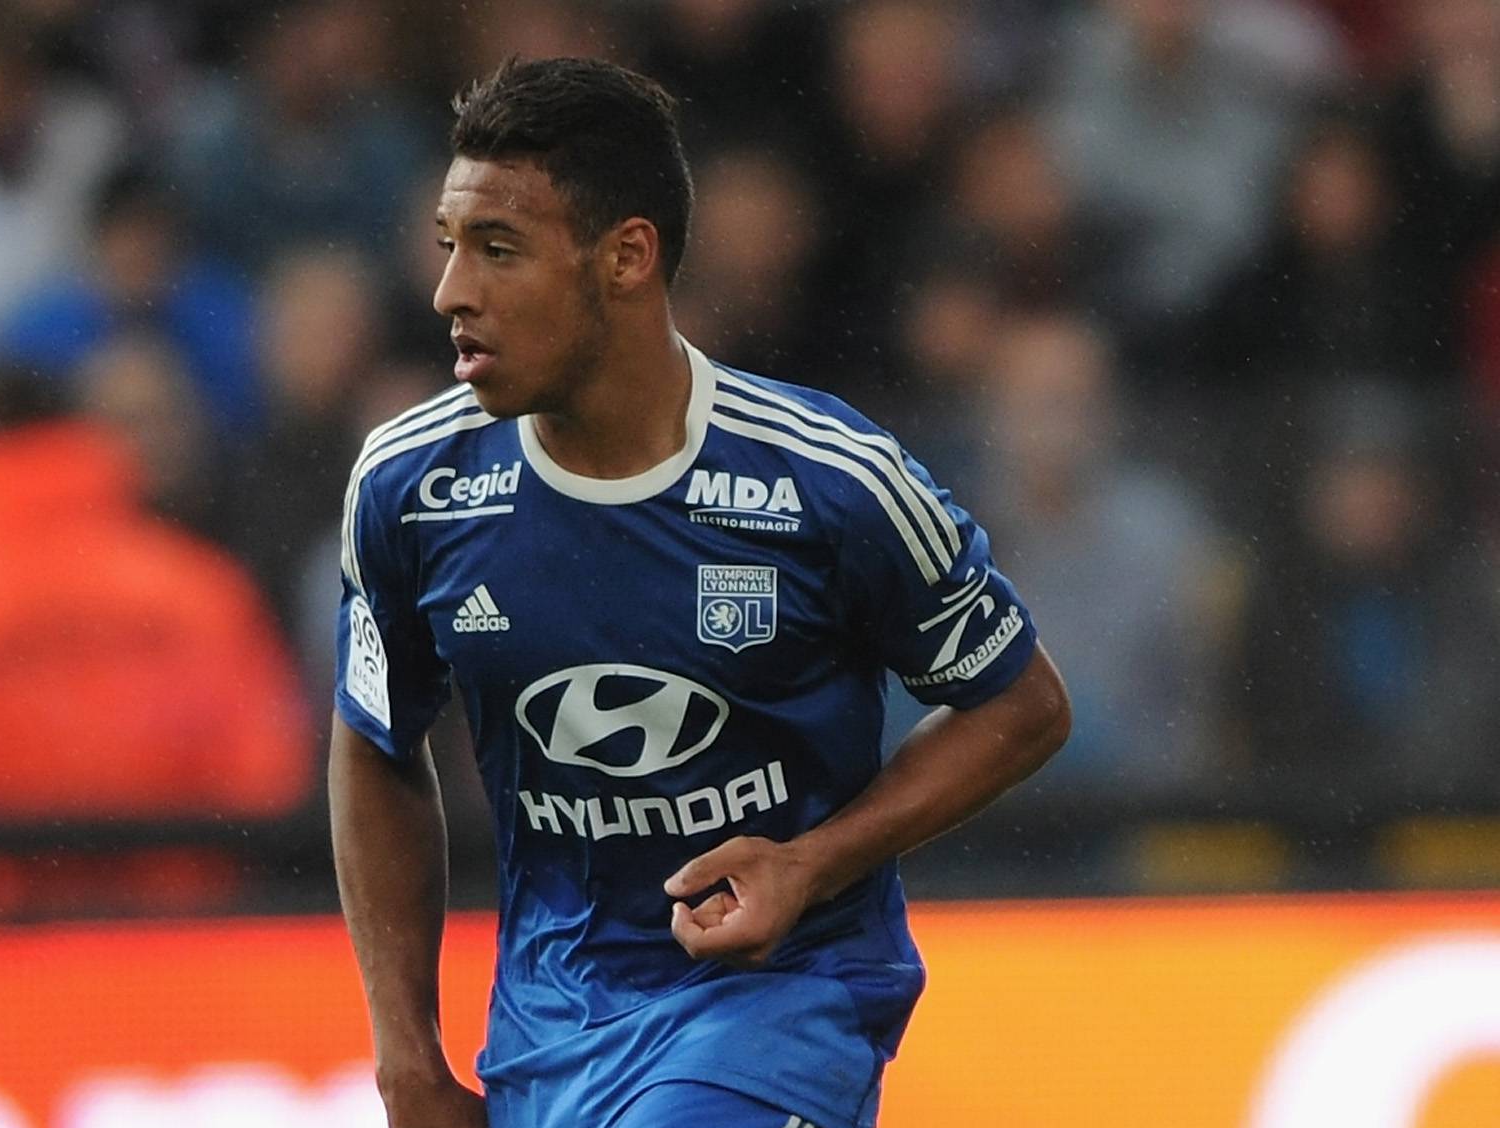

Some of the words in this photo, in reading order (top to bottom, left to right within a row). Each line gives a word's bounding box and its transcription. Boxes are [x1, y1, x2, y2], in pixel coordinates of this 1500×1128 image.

[419, 461, 522, 509] Cegid
[685, 469, 803, 512] MDA
[703, 569, 772, 581] OLYMPIQUE
[703, 580, 772, 592] LYONNAIS
[452, 613, 511, 633] adidas
[518, 760, 789, 841] HYUNDAI
